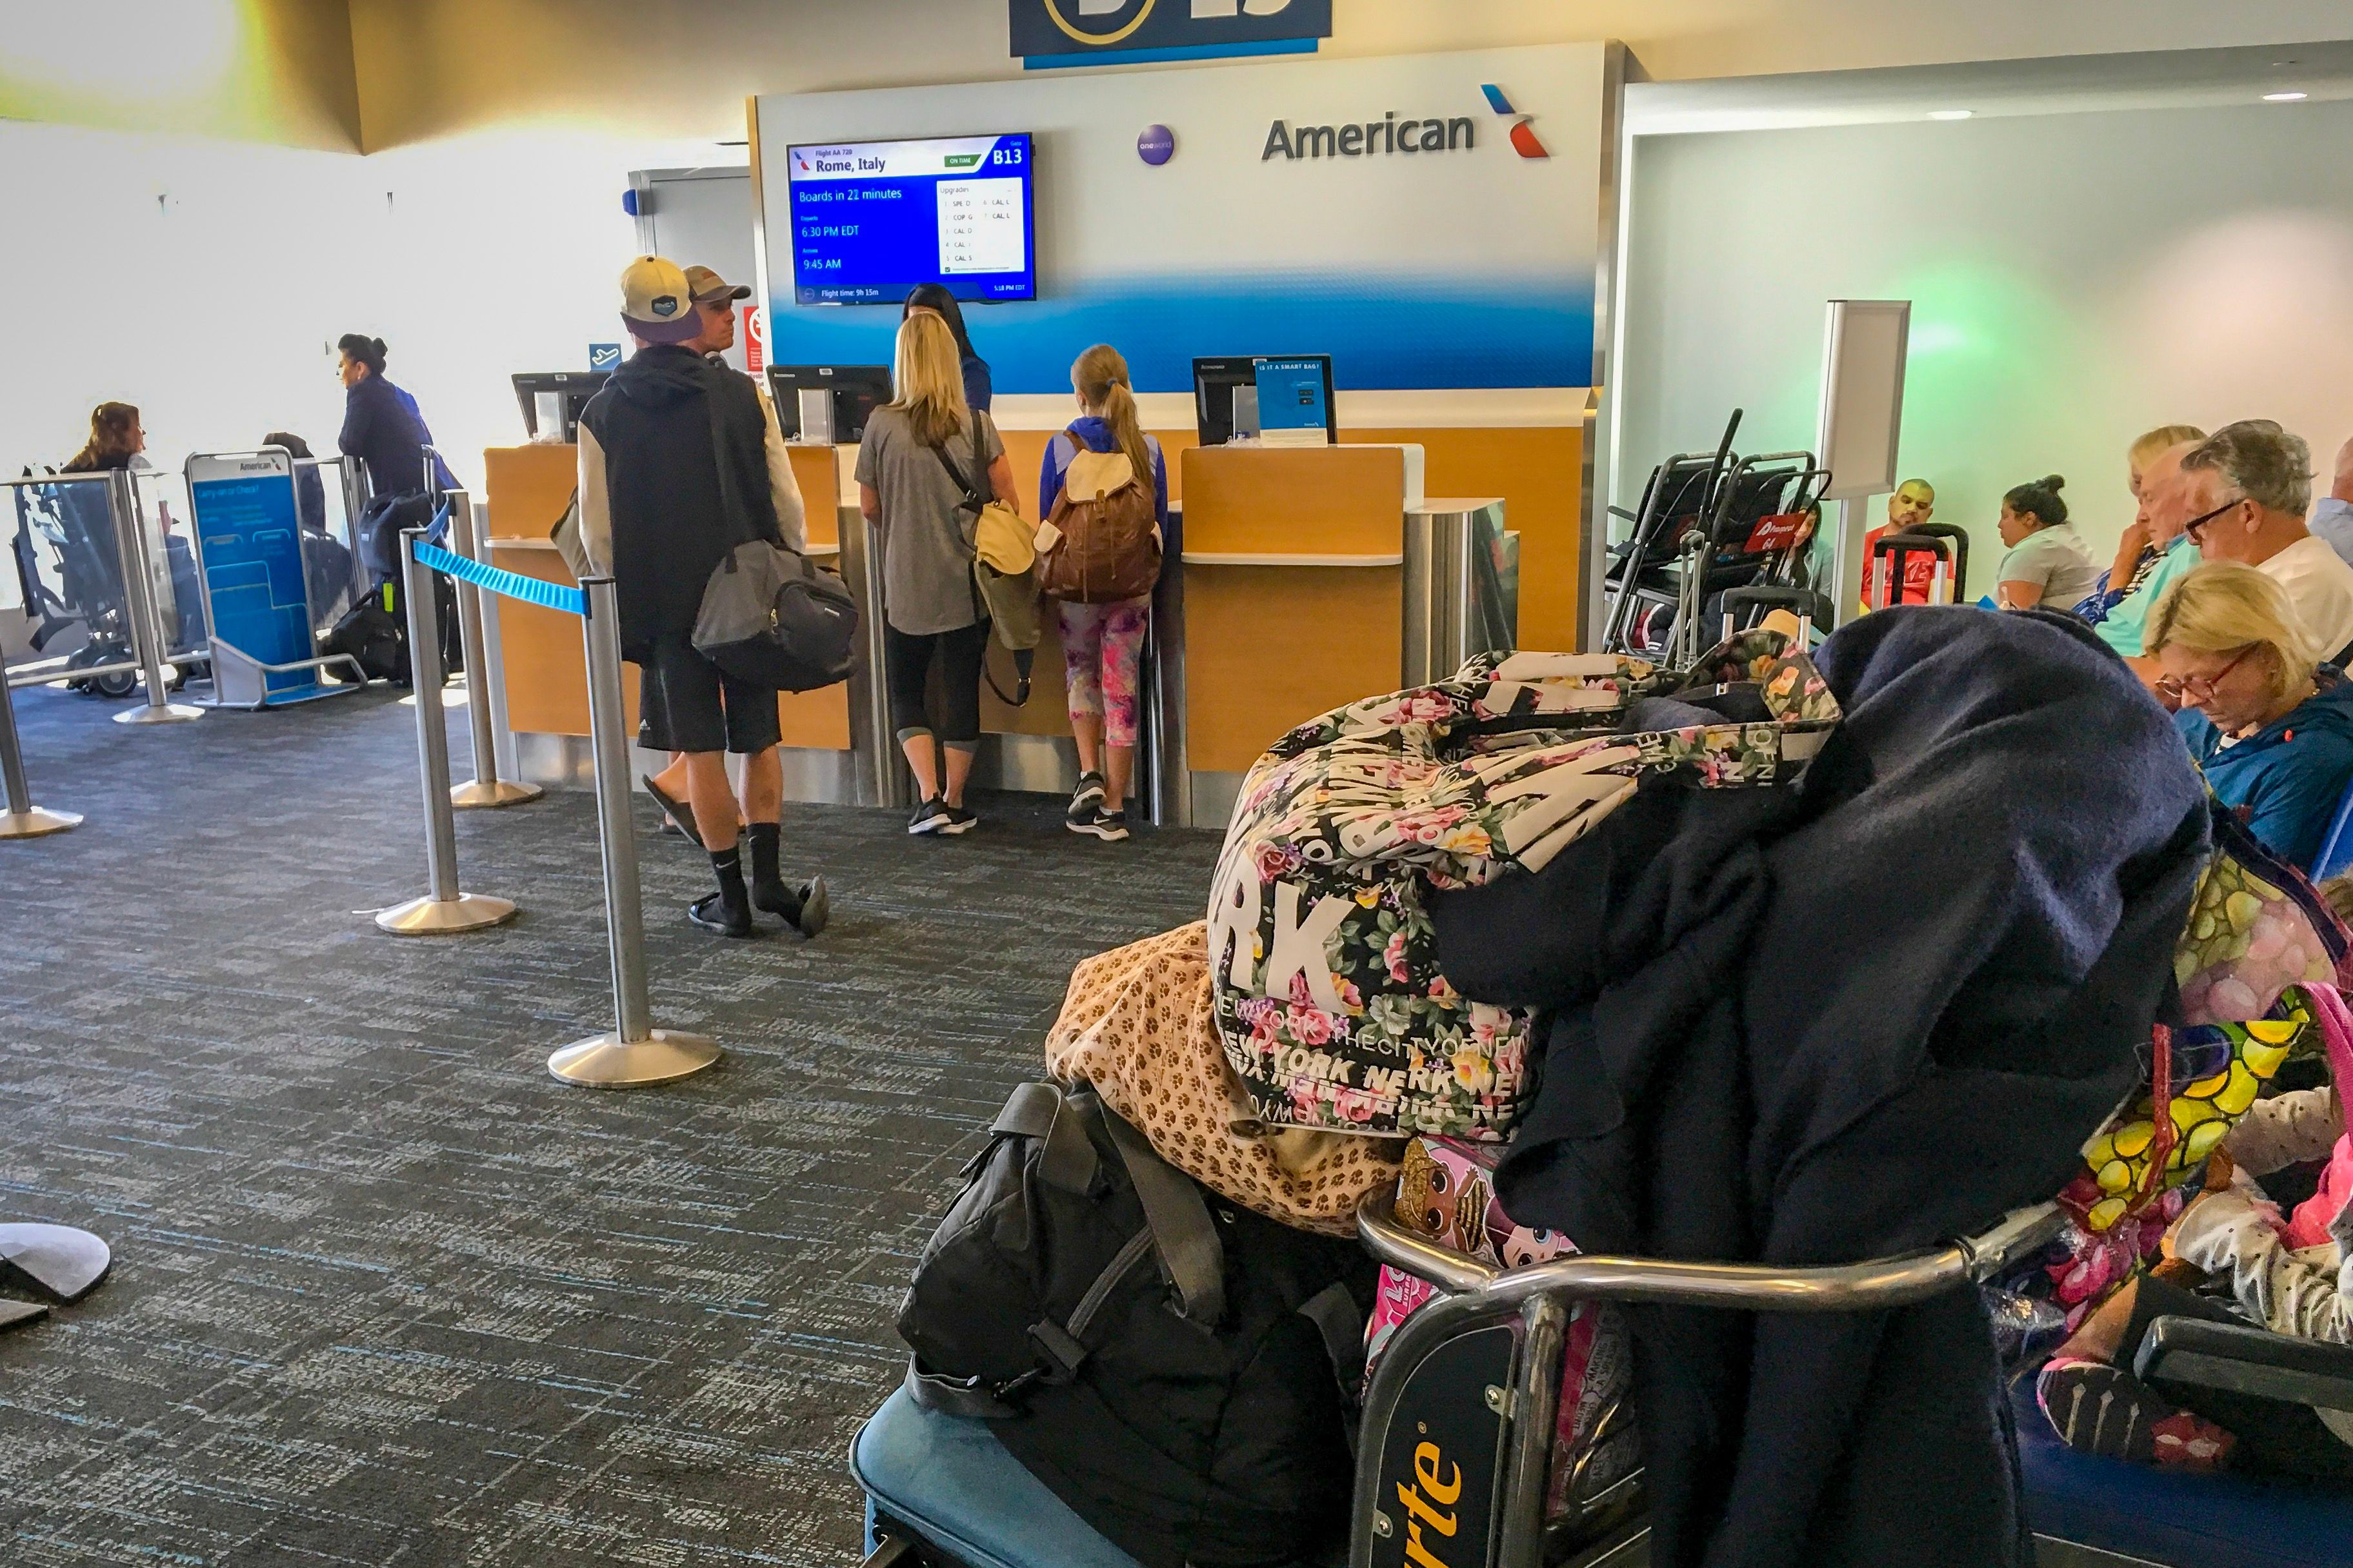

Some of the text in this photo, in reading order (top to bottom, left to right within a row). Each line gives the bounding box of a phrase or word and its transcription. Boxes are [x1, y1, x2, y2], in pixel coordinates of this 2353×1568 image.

[1261, 111, 1474, 161] American
[993, 148, 1022, 164] B13
[816, 157, 886, 172] Rome, Italy
[799, 191, 832, 203] Boards
[836, 190, 845, 201] in
[862, 188, 902, 200] minutes
[802, 225, 859, 237] 6:30 PM EDT
[803, 259, 841, 270] 9:45 AM
[821, 290, 838, 298] Flight
[239, 462, 271, 471] American
[1397, 1442, 1461, 1568] rte
